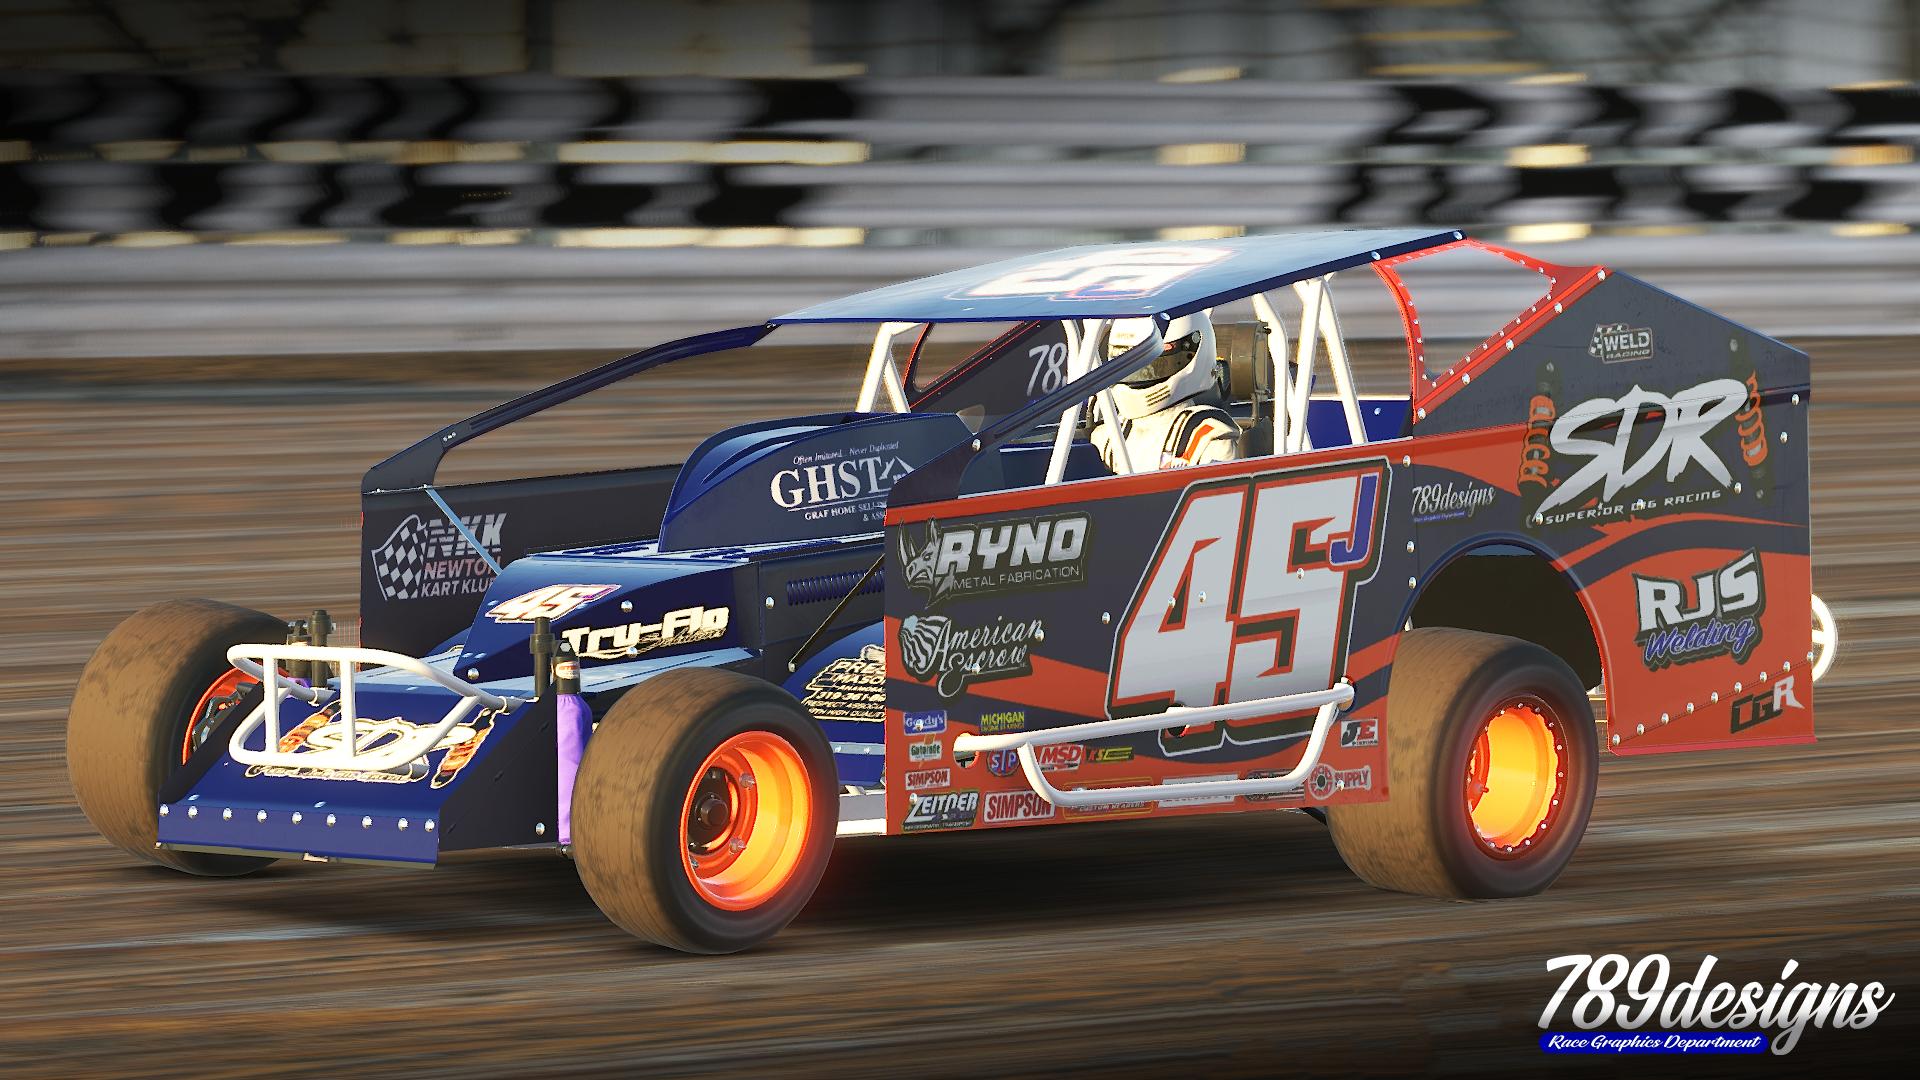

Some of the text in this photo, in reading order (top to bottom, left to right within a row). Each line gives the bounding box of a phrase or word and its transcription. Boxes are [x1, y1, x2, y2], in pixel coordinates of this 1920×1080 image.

[1603, 331, 1650, 351] WELD
[1606, 349, 1650, 359] RACING
[1026, 342, 1068, 397] 78
[1532, 378, 1748, 521] SDR
[1410, 481, 1497, 518] 789designs
[1631, 499, 1657, 515] DG
[1664, 489, 1721, 507] RACING
[804, 510, 829, 521] GRAF
[831, 505, 856, 517] HOME
[871, 511, 885, 521] ASS
[935, 517, 1088, 575] RYNO
[421, 582, 459, 598] KART
[953, 565, 1081, 590] METAL FABRICATION
[1637, 552, 1759, 631] RJS
[914, 616, 1044, 675] American
[1645, 617, 1756, 661] Welding
[938, 645, 1028, 698] Escrow
[1730, 675, 1805, 734] CGR
[905, 713, 944, 731] Gody's
[981, 711, 1025, 725] MICHIGAN
[1342, 720, 1376, 745] JE
[1041, 744, 1082, 764] MSD
[907, 770, 948, 786] SIMPSON
[987, 792, 1051, 820] SIMPSON
